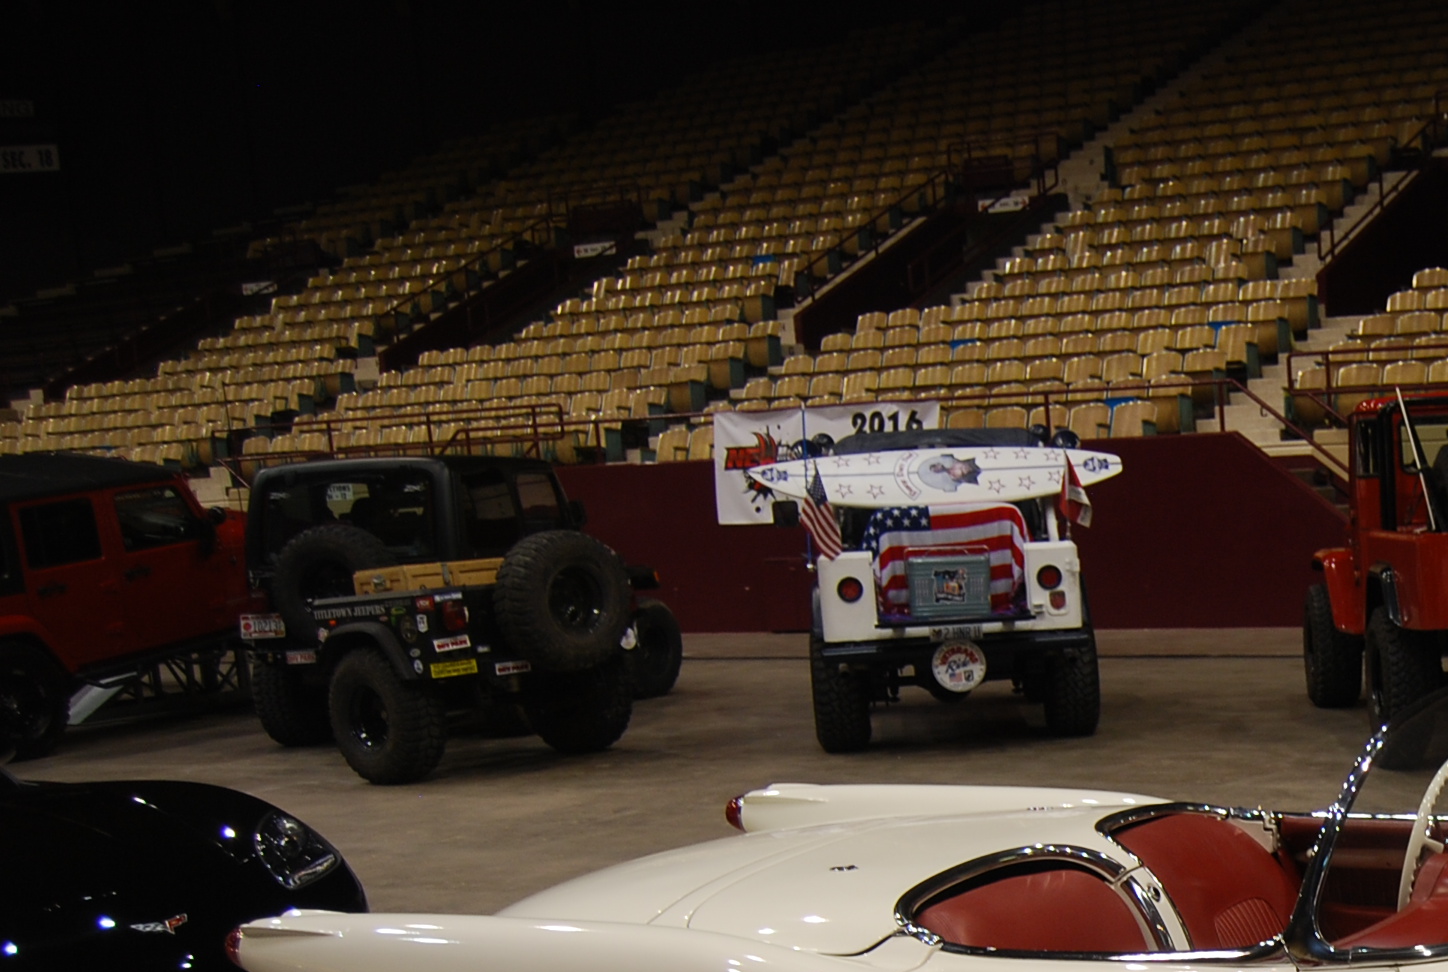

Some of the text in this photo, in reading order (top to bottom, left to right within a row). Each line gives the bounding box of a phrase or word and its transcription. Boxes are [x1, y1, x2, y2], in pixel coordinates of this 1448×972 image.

[2, 149, 53, 170] SEC. 18
[851, 409, 923, 433] 2016
[353, 604, 386, 617] JEEPERS
